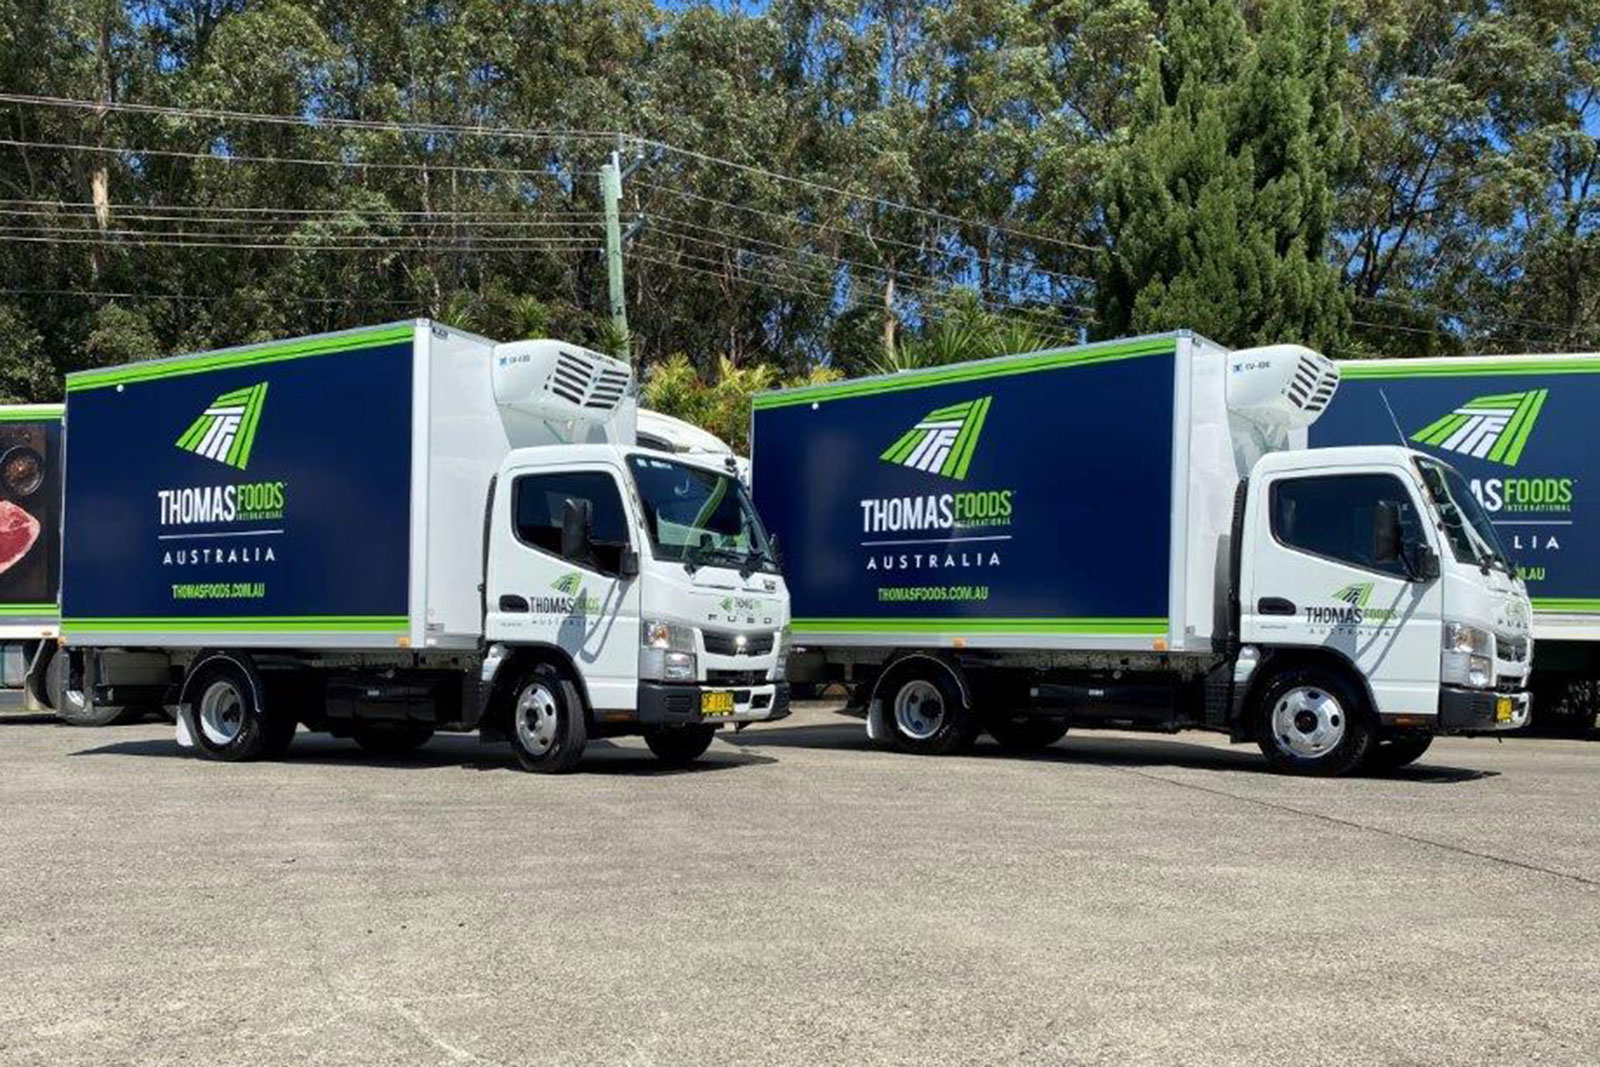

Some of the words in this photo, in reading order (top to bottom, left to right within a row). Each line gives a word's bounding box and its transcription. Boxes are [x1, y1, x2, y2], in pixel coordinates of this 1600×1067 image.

[1503, 478, 1573, 503] FOODS
[158, 485, 236, 525] THOMAS
[237, 481, 284, 511] FOODS
[860, 494, 953, 533] THOMAS
[955, 490, 1012, 519] FOODS
[1503, 503, 1572, 512] INTERNATIONAL
[162, 547, 275, 565] AUSTRALIA
[866, 552, 1000, 570] AUSTRALIA
[172, 583, 265, 599] THOMASFOODS.COM.AU
[878, 586, 989, 601] THOMASFOODS.COM.AU
[529, 596, 574, 614] THOMAS
[1305, 606, 1363, 624] THOMAS
